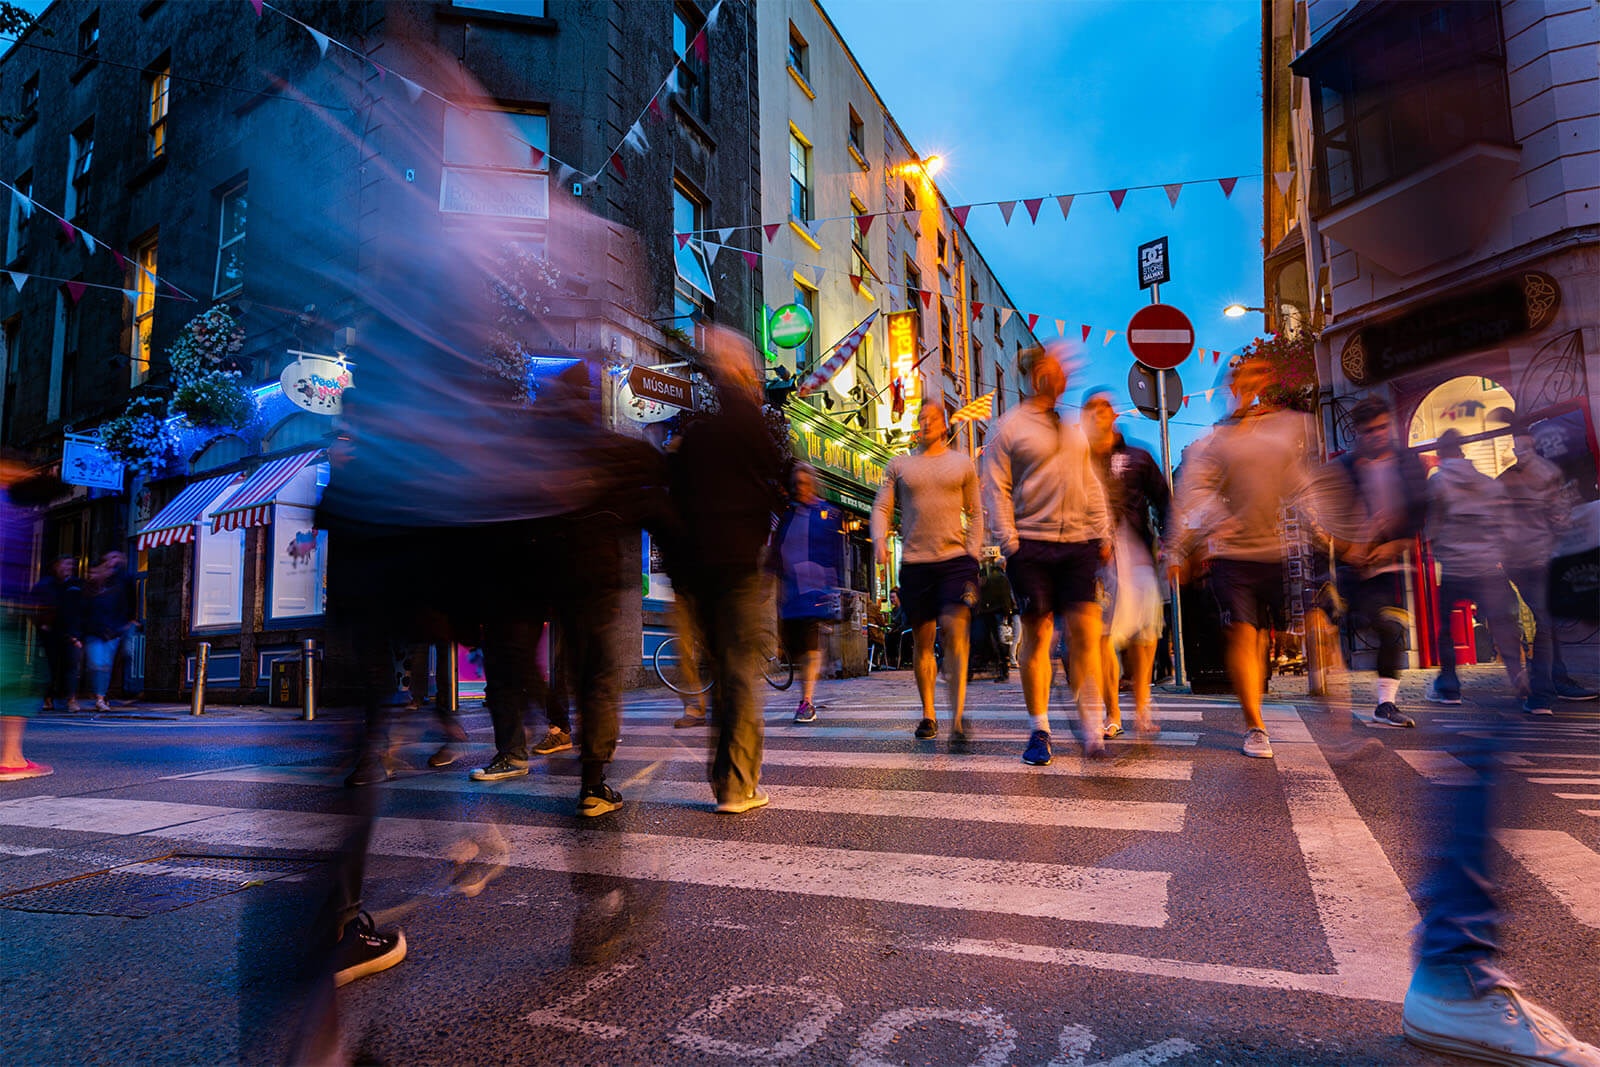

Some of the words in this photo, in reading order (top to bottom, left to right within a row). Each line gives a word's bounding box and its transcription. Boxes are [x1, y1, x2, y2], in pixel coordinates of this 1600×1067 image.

[1142, 243, 1163, 268] DC
[1143, 262, 1164, 275] STORE
[1143, 271, 1164, 281] GALWAY
[312, 374, 341, 389] Peek
[642, 377, 683, 399] MÚSAEM
